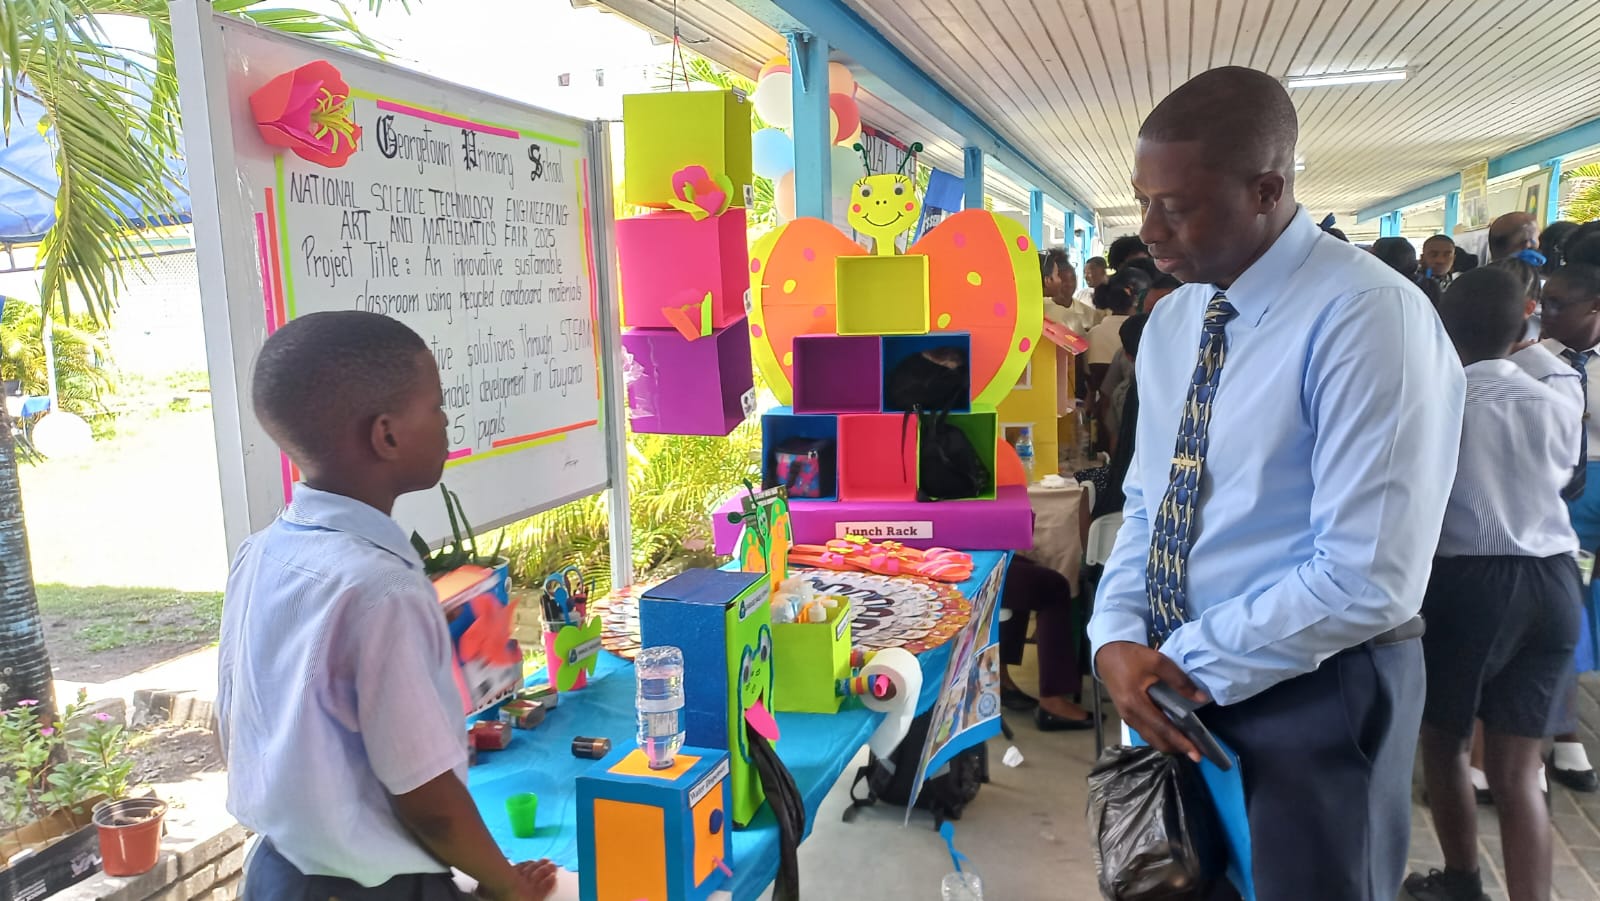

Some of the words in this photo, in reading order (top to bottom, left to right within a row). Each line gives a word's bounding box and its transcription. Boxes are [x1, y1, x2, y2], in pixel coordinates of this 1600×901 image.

[376, 115, 452, 175] Georgetown
[461, 129, 514, 190] Primary
[528, 144, 564, 183] School
[290, 172, 360, 208] NATIONAL
[370, 182, 426, 214] SCIENCE
[427, 188, 494, 220] TECHNOLOGY
[505, 197, 569, 226] ENGINEERING
[341, 210, 371, 240] ART
[390, 215, 413, 243] AND
[422, 217, 496, 246] MATHEMATICS
[504, 223, 528, 247] FAIR
[533, 227, 556, 248] 2025
[301, 235, 353, 287] Project
[424, 245, 443, 276] An
[453, 247, 503, 276] innovative
[355, 279, 419, 315] classroom
[425, 286, 453, 325] using
[459, 279, 494, 320] recycled
[500, 279, 542, 307] cardboard
[548, 275, 581, 304] materials
[431, 334, 453, 370] tive
[467, 326, 515, 367] solutions
[519, 322, 553, 365] through
[560, 318, 593, 353] STEAM
[480, 362, 529, 408] development
[533, 369, 543, 393] in
[549, 357, 583, 398] Guyana
[453, 413, 466, 445] 5
[477, 402, 506, 449] pupils
[845, 526, 883, 537] Lunch
[886, 526, 918, 537] Rack
